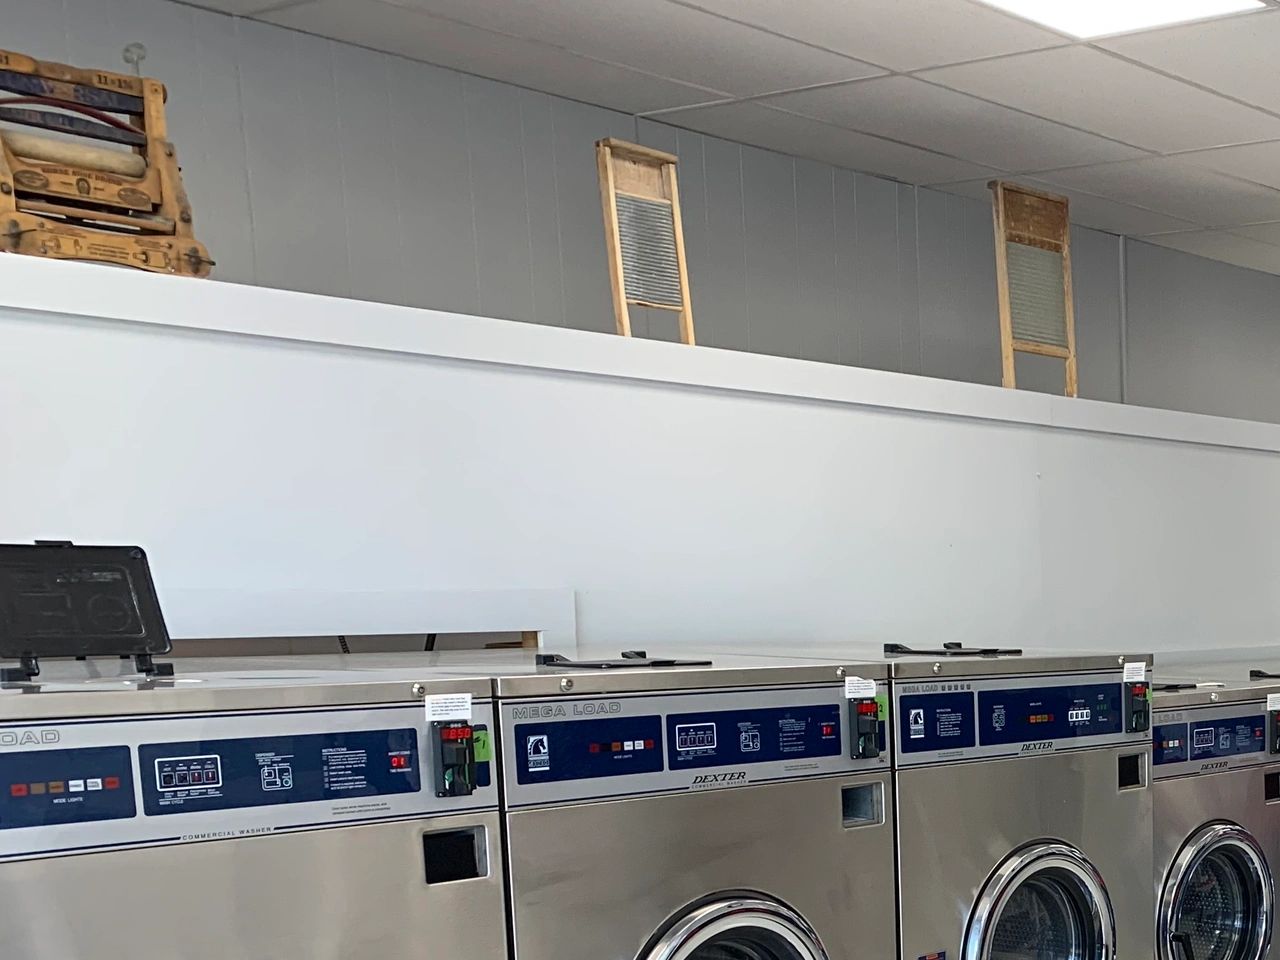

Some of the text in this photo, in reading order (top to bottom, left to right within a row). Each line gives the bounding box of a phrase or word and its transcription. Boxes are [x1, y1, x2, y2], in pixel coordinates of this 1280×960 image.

[512, 702, 622, 720] MEGA LOAD
[1021, 742, 1053, 752] DEXTER
[1200, 761, 1229, 771] DEXTER
[692, 771, 747, 785] DEXTER
[182, 826, 272, 841] COMMERCIAL WASHER
